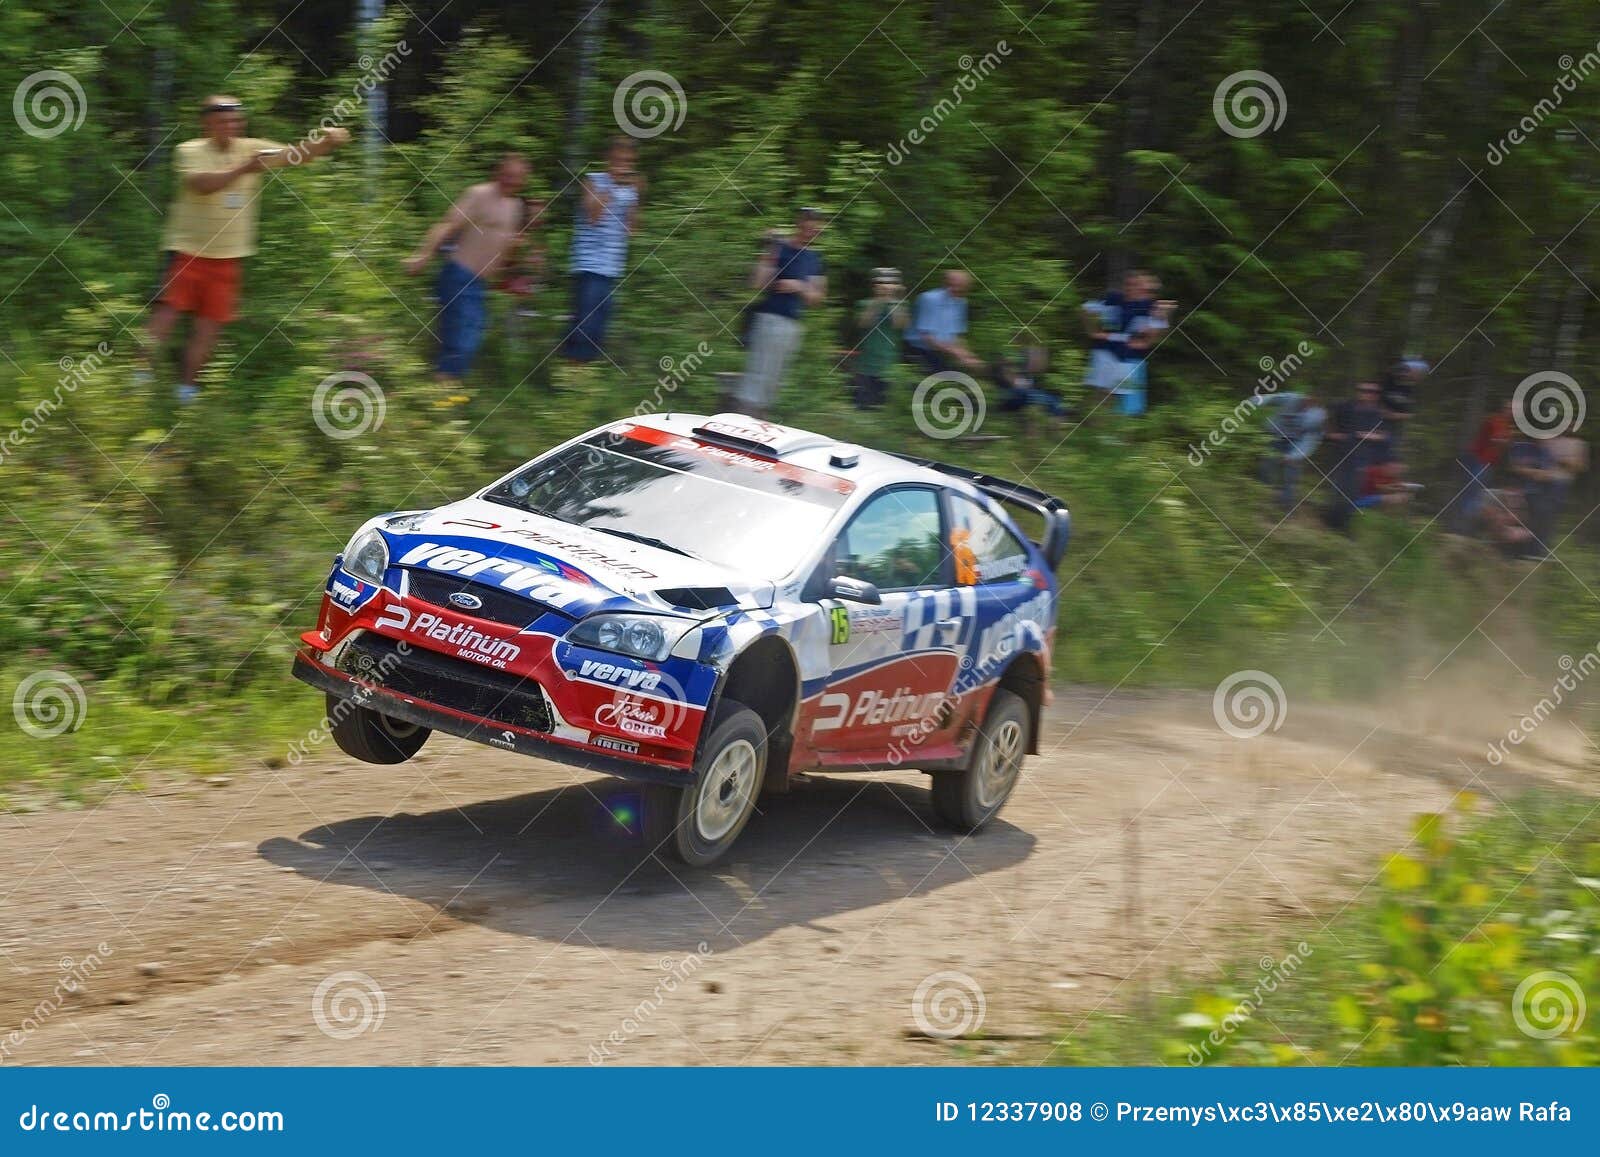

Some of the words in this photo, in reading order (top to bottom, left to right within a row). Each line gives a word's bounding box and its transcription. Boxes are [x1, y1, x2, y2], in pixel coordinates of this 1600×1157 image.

[502, 529, 659, 580] Platinum
[399, 542, 591, 608] verva
[410, 612, 521, 662] Platinum
[830, 606, 850, 645] 15
[457, 648, 493, 664] MOTOR
[492, 657, 507, 670] OIL
[580, 659, 662, 691] verva
[591, 739, 640, 755] IRELLI
